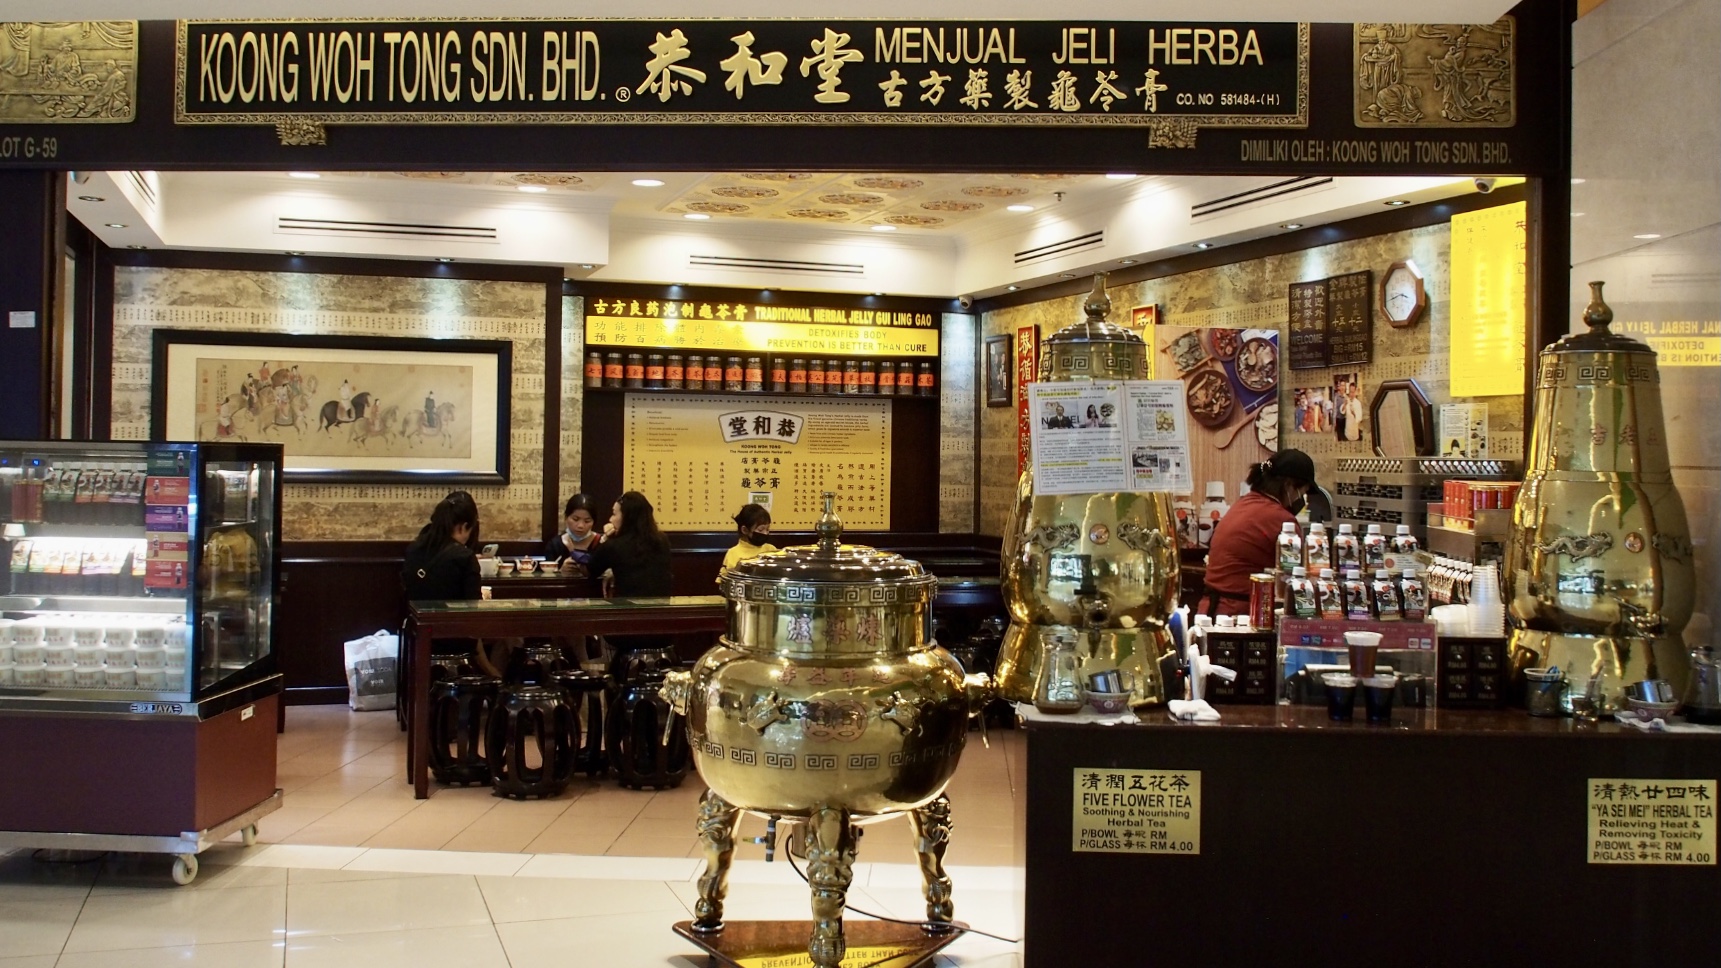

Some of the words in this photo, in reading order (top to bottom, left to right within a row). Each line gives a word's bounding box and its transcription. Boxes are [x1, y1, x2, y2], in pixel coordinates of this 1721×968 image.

[874, 28, 1026, 64] MENJUAL
[1052, 28, 1115, 65] JELI
[1148, 28, 1263, 66] HERBA
[200, 31, 299, 103] KOONG
[308, 31, 374, 102] WOH
[383, 31, 461, 102] TONG
[470, 31, 534, 102] SDN.
[544, 31, 605, 101] BHD.
[636, 28, 864, 105] 恭和堂
[1176, 94, 1195, 106] CO.
[1198, 94, 1214, 106] NO
[0, 137, 21, 158] OT
[25, 137, 57, 158] G-59
[1241, 140, 1288, 162] DIMILIKI
[1332, 141, 1377, 162] KOONG
[1381, 141, 1410, 163] WOH
[1415, 141, 1449, 163] TONG
[1452, 141, 1480, 163] SDN.
[1482, 142, 1512, 164] BHD.
[754, 306, 811, 322] TRADITIONAL
[813, 308, 847, 324] HERBAL
[848, 310, 874, 325] JELLY
[875, 311, 891, 325] GUI
[893, 312, 912, 327] LING
[915, 313, 932, 327] GAO
[808, 328, 859, 339] DETOXIFIES
[863, 330, 887, 340] BODY
[1291, 333, 1323, 345] WELCOME
[767, 339, 825, 349] PREVENTION
[828, 340, 836, 350] IS
[840, 341, 873, 351] BETTER
[877, 342, 901, 351] THAN
[904, 343, 927, 353] CURE
[1594, 782, 1711, 801] 清熱廿四味
[1083, 792, 1109, 807] FIVE
[1112, 793, 1165, 808] FLOWER
[1168, 794, 1192, 808] TEA
[1082, 807, 1125, 818] Soothing
[1128, 808, 1135, 817] &
[1138, 808, 1190, 820] Nourishing
[1611, 804, 1626, 818] SEI
[1652, 805, 1691, 818] HERBAL
[1694, 805, 1713, 818] TEA
[1107, 818, 1144, 827] Herbal
[1147, 819, 1166, 828] Tea
[1599, 819, 1657, 830] Relieving
[1660, 820, 1688, 829] Heat
[1692, 820, 1701, 829] &
[1081, 828, 1119, 839] P/BOWL
[1150, 830, 1167, 840] RM
[1599, 829, 1656, 840] Removing
[1660, 830, 1703, 840] Toxicity
[1079, 839, 1121, 849] P/GLASS
[1150, 841, 1167, 850] RM
[1169, 841, 1193, 852] 4.00
[1595, 840, 1633, 851] P/BOWL
[1665, 841, 1682, 851] RM
[1593, 851, 1635, 861] P/GLASS
[1665, 852, 1682, 861] RM
[1686, 853, 1710, 862] 4.00
